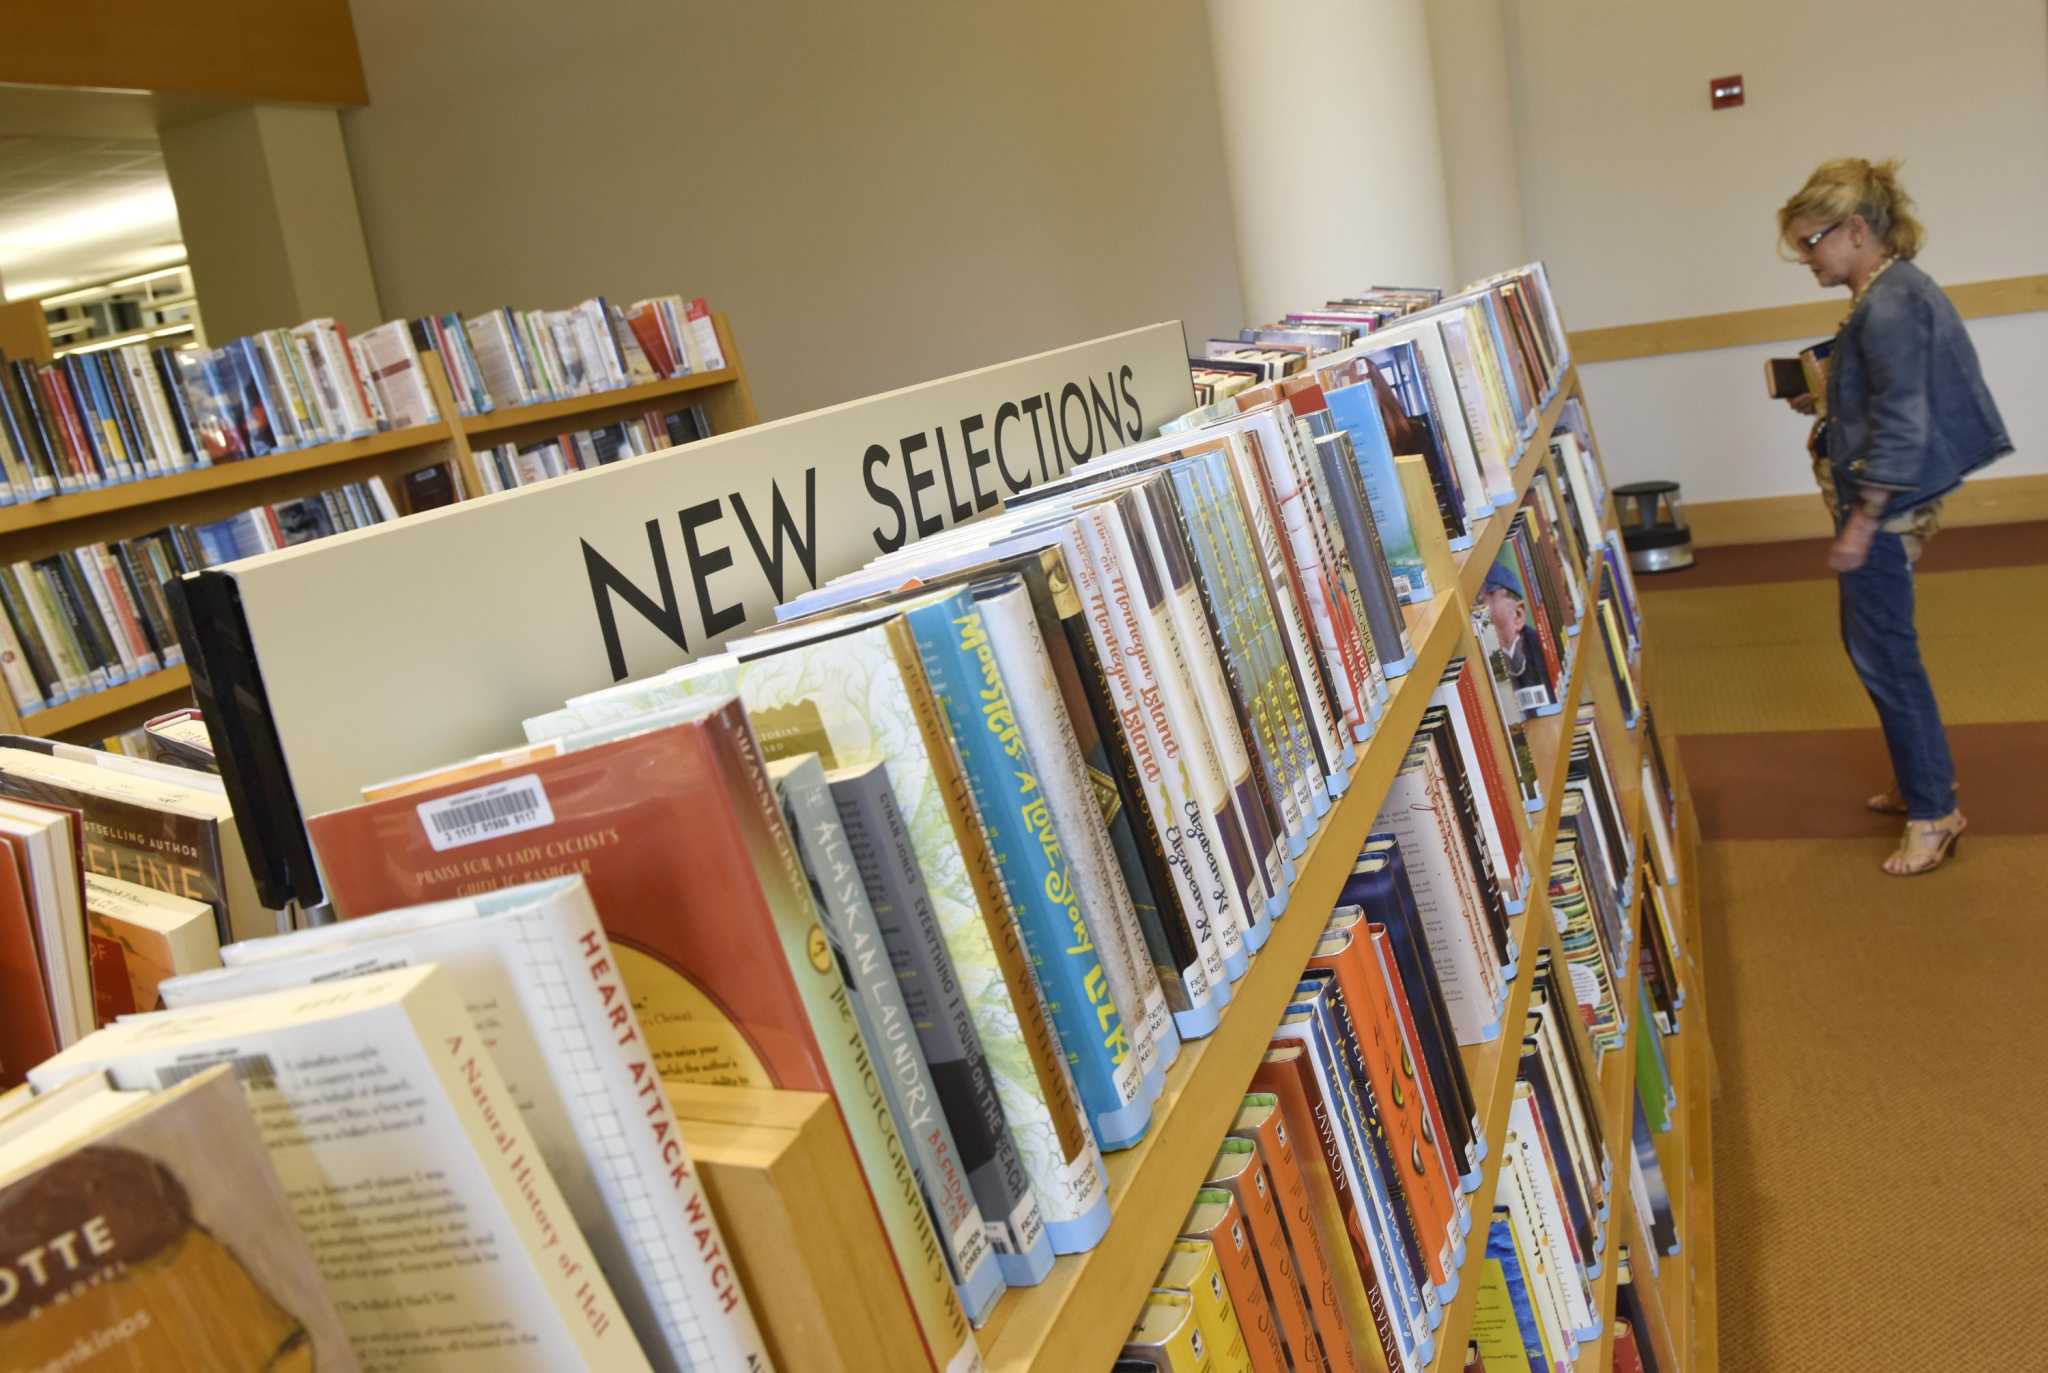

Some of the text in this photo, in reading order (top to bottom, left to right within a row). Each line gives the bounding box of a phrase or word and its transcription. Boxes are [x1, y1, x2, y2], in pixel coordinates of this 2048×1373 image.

[580, 467, 816, 683] NEW
[862, 364, 1144, 553] SELECTIONS
[1091, 588, 1134, 700] Monhegan
[1120, 703, 1160, 784] Island
[1111, 572, 1153, 680] Monhegan
[1140, 681, 1179, 759] Island
[1351, 625, 1371, 683] WATCH
[1012, 765, 1035, 793] A
[1253, 696, 1292, 797] KENNEDY
[150, 837, 198, 858] AUTHOR
[416, 865, 460, 886] PRAISE
[463, 856, 491, 876] FOR
[509, 844, 542, 867] LADY
[1023, 798, 1063, 862] LOVE
[813, 818, 881, 974] ALASKAN
[870, 982, 933, 1128] LAUNDRY
[879, 792, 901, 836] CYNAN
[894, 839, 917, 886] JONES
[913, 896, 955, 996] EVERYTHING
[951, 1011, 980, 1063] FOUND
[978, 1090, 1006, 1132] THE
[994, 1132, 1025, 1202] BEACH
[1335, 986, 1366, 1072] HARPER
[1365, 1080, 1380, 1116] LEE
[578, 930, 637, 1045] HEART
[627, 1061, 690, 1188] ATTACK
[684, 1193, 738, 1314] WATCH
[1315, 1102, 1346, 1192] LAWSON
[461, 1057, 516, 1154] Natural
[511, 1154, 559, 1250] History
[558, 1252, 584, 1279] of
[576, 1282, 611, 1339] Hell
